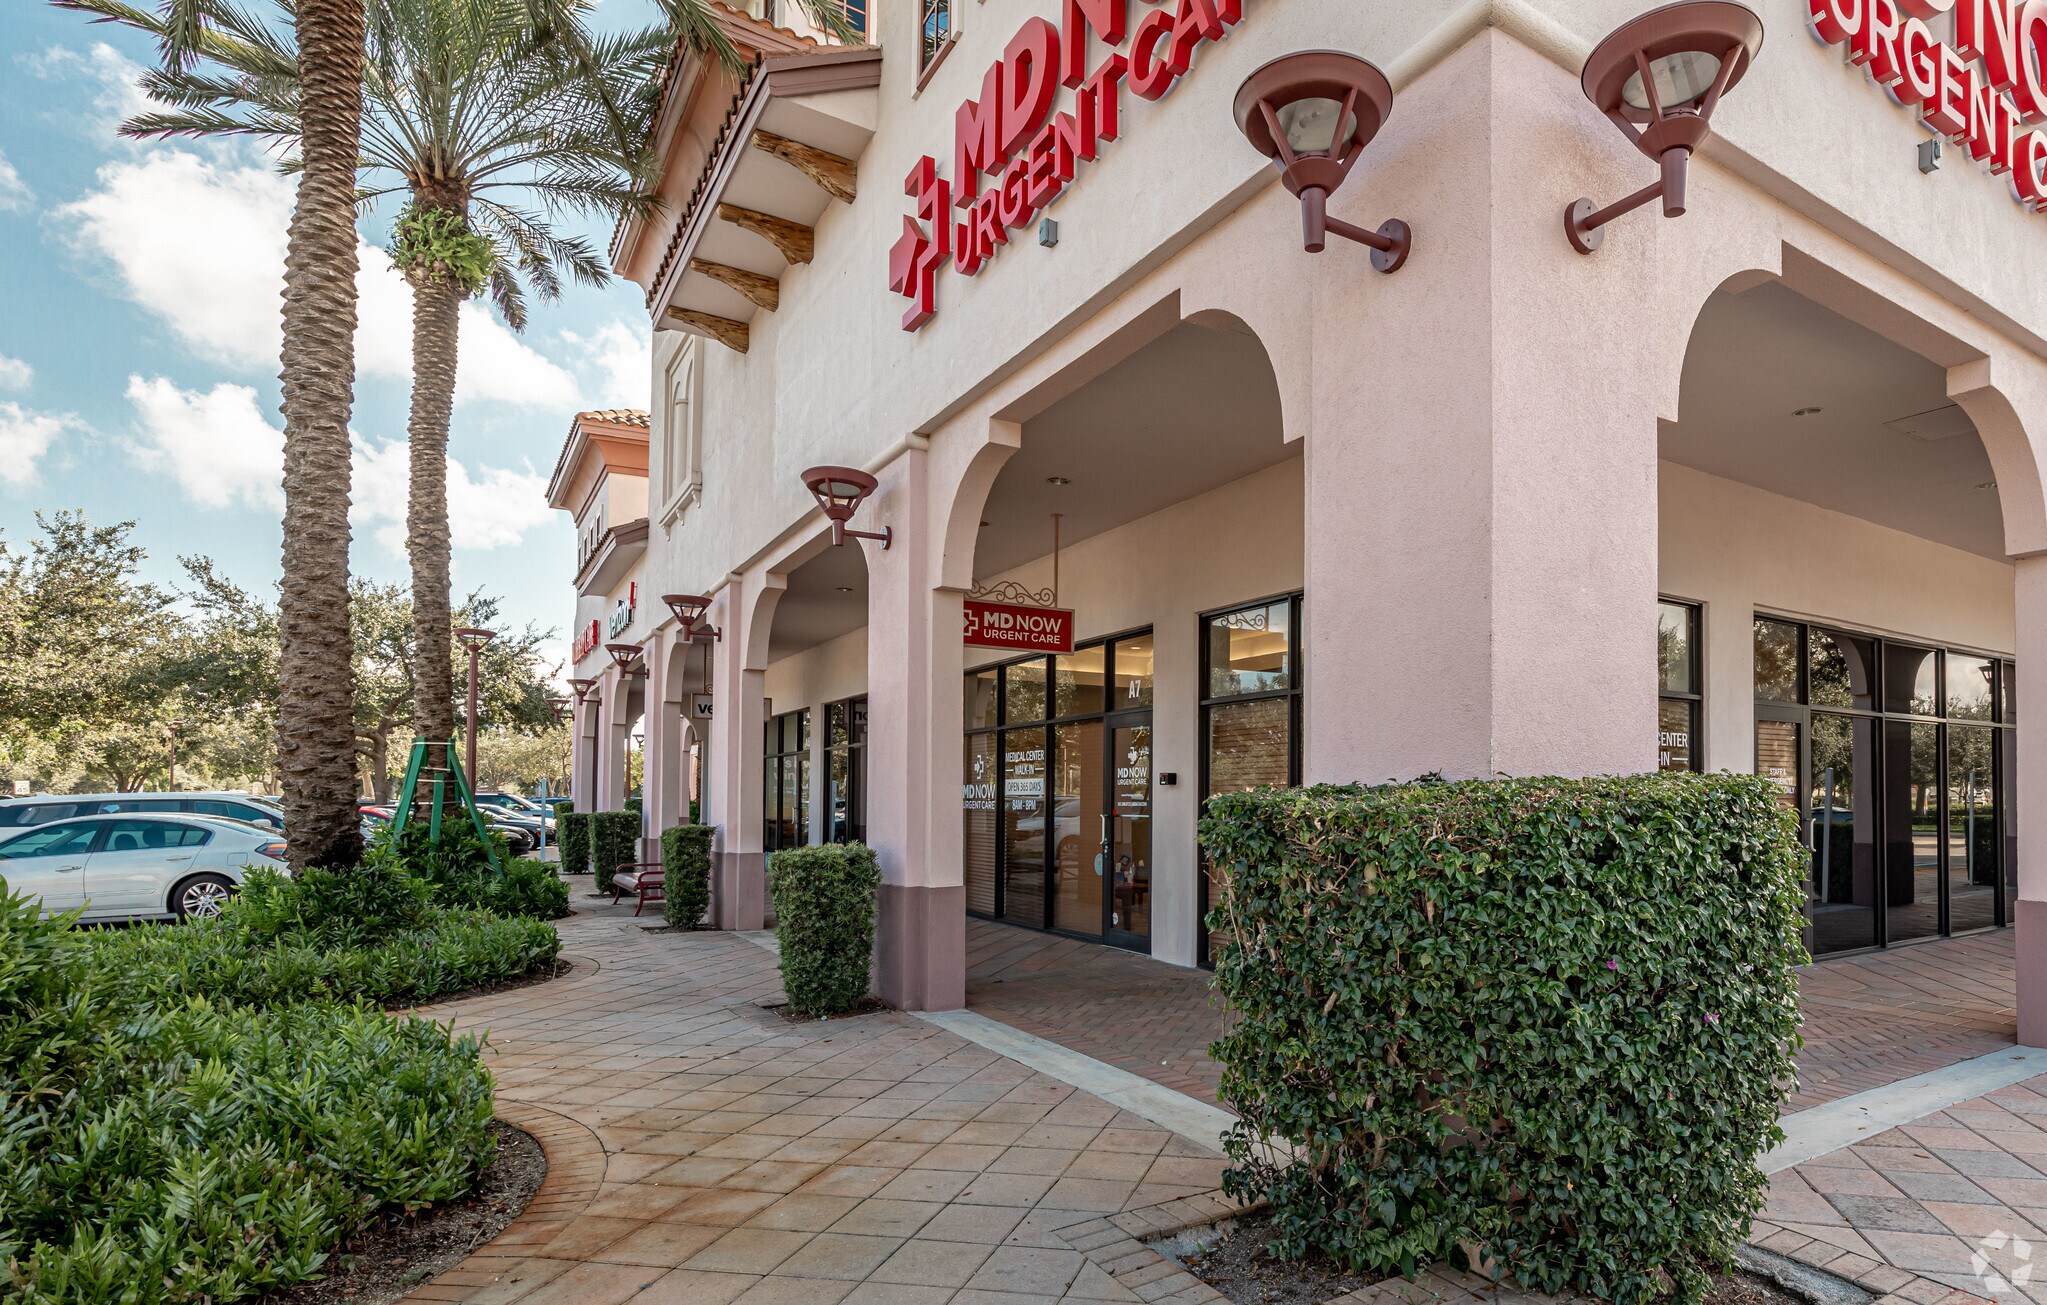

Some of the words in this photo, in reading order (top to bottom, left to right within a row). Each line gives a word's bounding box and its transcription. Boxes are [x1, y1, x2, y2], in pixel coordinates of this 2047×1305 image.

[954, 16, 1060, 208] MD
[954, 53, 1128, 276] URGENT
[1128, 0, 1243, 101] CA
[983, 611, 1014, 629] MD
[1016, 614, 1062, 634] NOW
[983, 629, 1029, 642] URGENT
[1031, 633, 1061, 644] CARE
[1128, 679, 1141, 699] A7
[1005, 751, 1025, 762] MEDICAL
[1026, 750, 1045, 761] CENTER
[1117, 768, 1129, 778] MD
[1129, 767, 1147, 778] NOW
[962, 784, 974, 799] MD
[975, 783, 996, 799] NOW
[1007, 782, 1019, 792] OPEN
[1020, 782, 1029, 791] 365
[1029, 781, 1042, 791] DAYS
[981, 800, 996, 810] CARE
